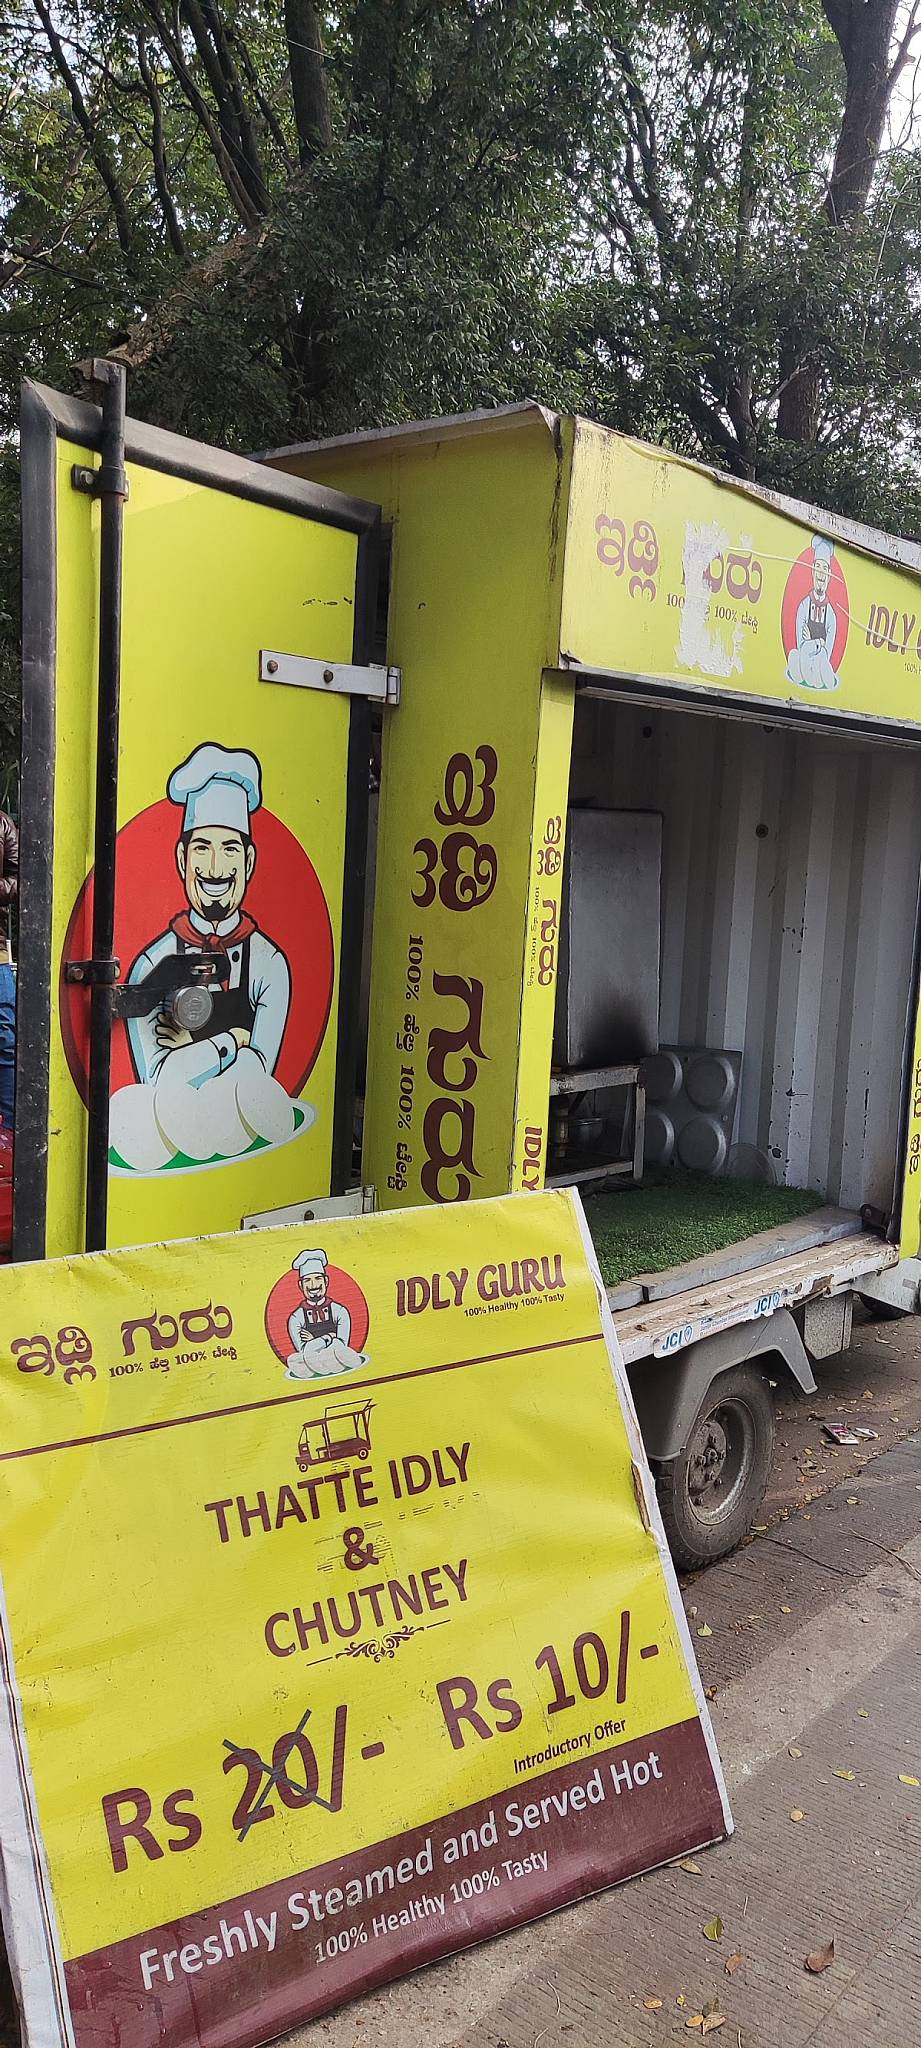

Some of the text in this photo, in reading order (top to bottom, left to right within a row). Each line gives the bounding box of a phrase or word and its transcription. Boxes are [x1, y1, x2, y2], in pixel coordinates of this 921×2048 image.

[594, 513, 660, 603] ಇಡ್ಲಿ
[665, 592, 687, 609] 100
[714, 604, 738, 623] 100%
[865, 603, 917, 656] IDLY
[535, 814, 562, 987] ಇಡ್ಲಿ ಗುರು
[405, 934, 424, 1001] 100%
[410, 743, 498, 1204] ಇಡ್ಲಿ ಗುರು
[397, 1063, 415, 1130] 100%
[521, 1126, 543, 1191] IDLY
[395, 1254, 567, 1317] IDLY GURU
[463, 1292, 565, 1318] 100% Healthy 100% Tasty
[754, 1295, 772, 1314] JCI
[10, 1298, 234, 1385] ಇಡ್ಲಿ ಗುರು
[108, 1362, 144, 1378] 100%
[174, 1350, 208, 1365] 100%
[661, 1330, 683, 1350] JCI
[204, 1442, 471, 1544] THATTE IDLY
[342, 1526, 380, 1571] &
[264, 1558, 468, 1658] CHUTNEY
[436, 1610, 660, 1750] Rs 10/-
[513, 1718, 627, 1775] Introductory Offer
[101, 1704, 385, 1873] Rs 20/-
[139, 1751, 664, 1991] Freshly Steamed and Served Hot
[314, 1850, 549, 1965] 100% Healthy 100% Tasty
